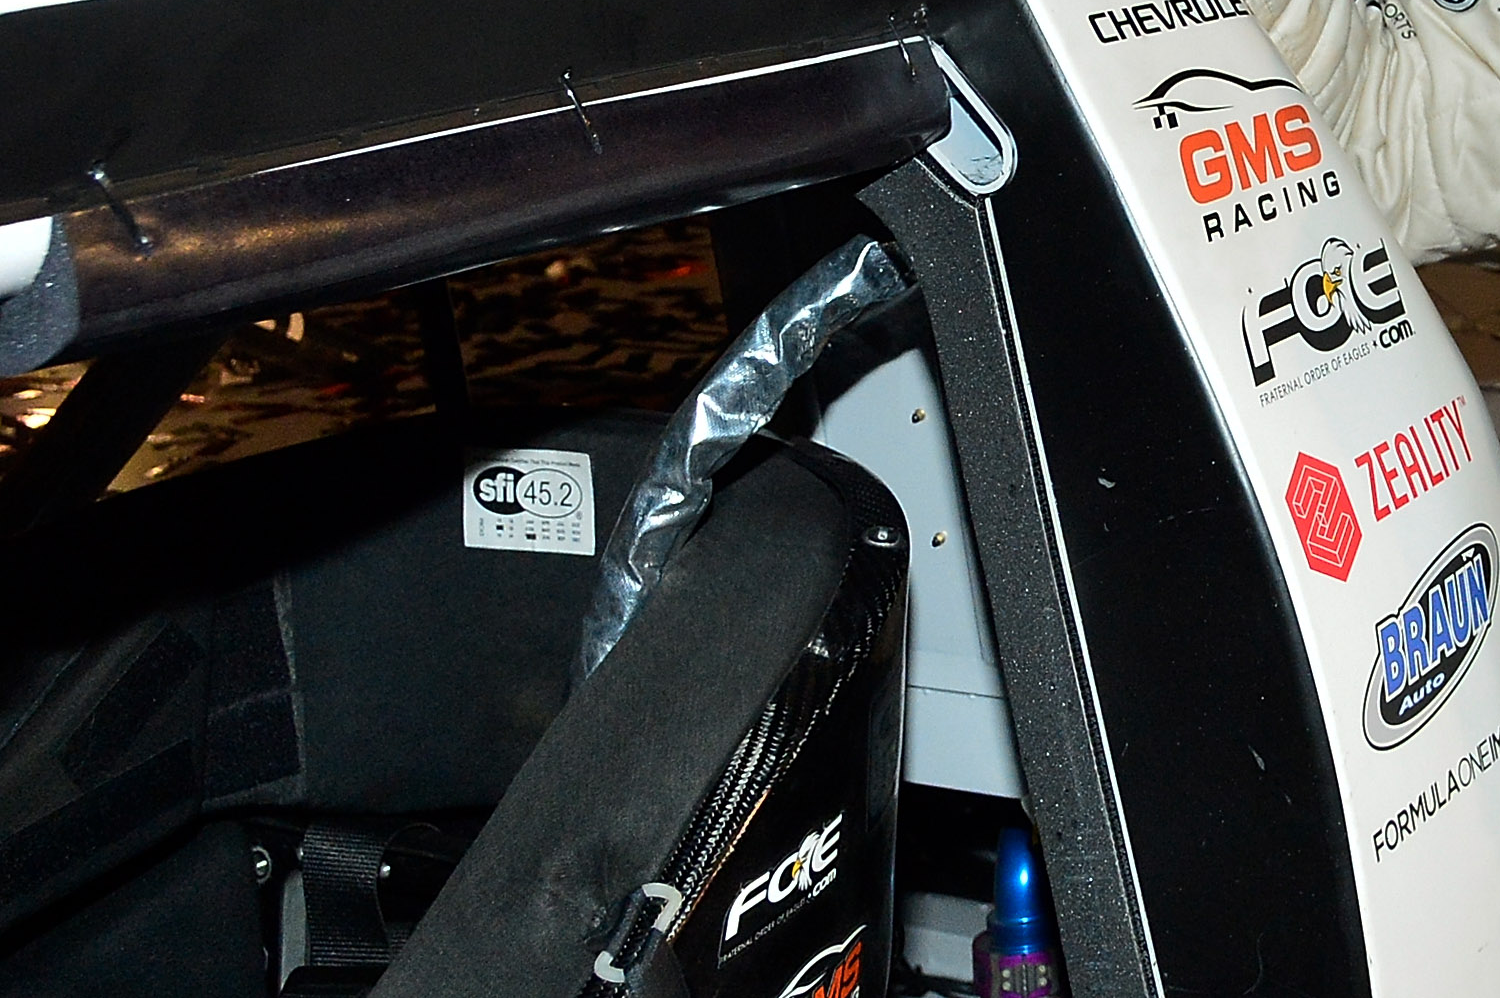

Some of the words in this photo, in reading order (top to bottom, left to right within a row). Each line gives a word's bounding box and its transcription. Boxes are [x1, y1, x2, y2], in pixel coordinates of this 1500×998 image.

[1179, 103, 1324, 204] GMS
[1203, 170, 1341, 242] RACING
[1242, 238, 1407, 387] FOE
[1259, 381, 1303, 408] FRATERNAL
[1303, 362, 1331, 386] ORDER
[1331, 356, 1343, 372] OF
[1343, 342, 1371, 366] EAGLES
[479, 472, 515, 504] sfi
[523, 480, 574, 508] 45.2
[1354, 400, 1473, 522] ZEALITY
[1377, 553, 1491, 702] BRAUN
[1398, 672, 1446, 716] Auto
[724, 812, 844, 941] FOE
